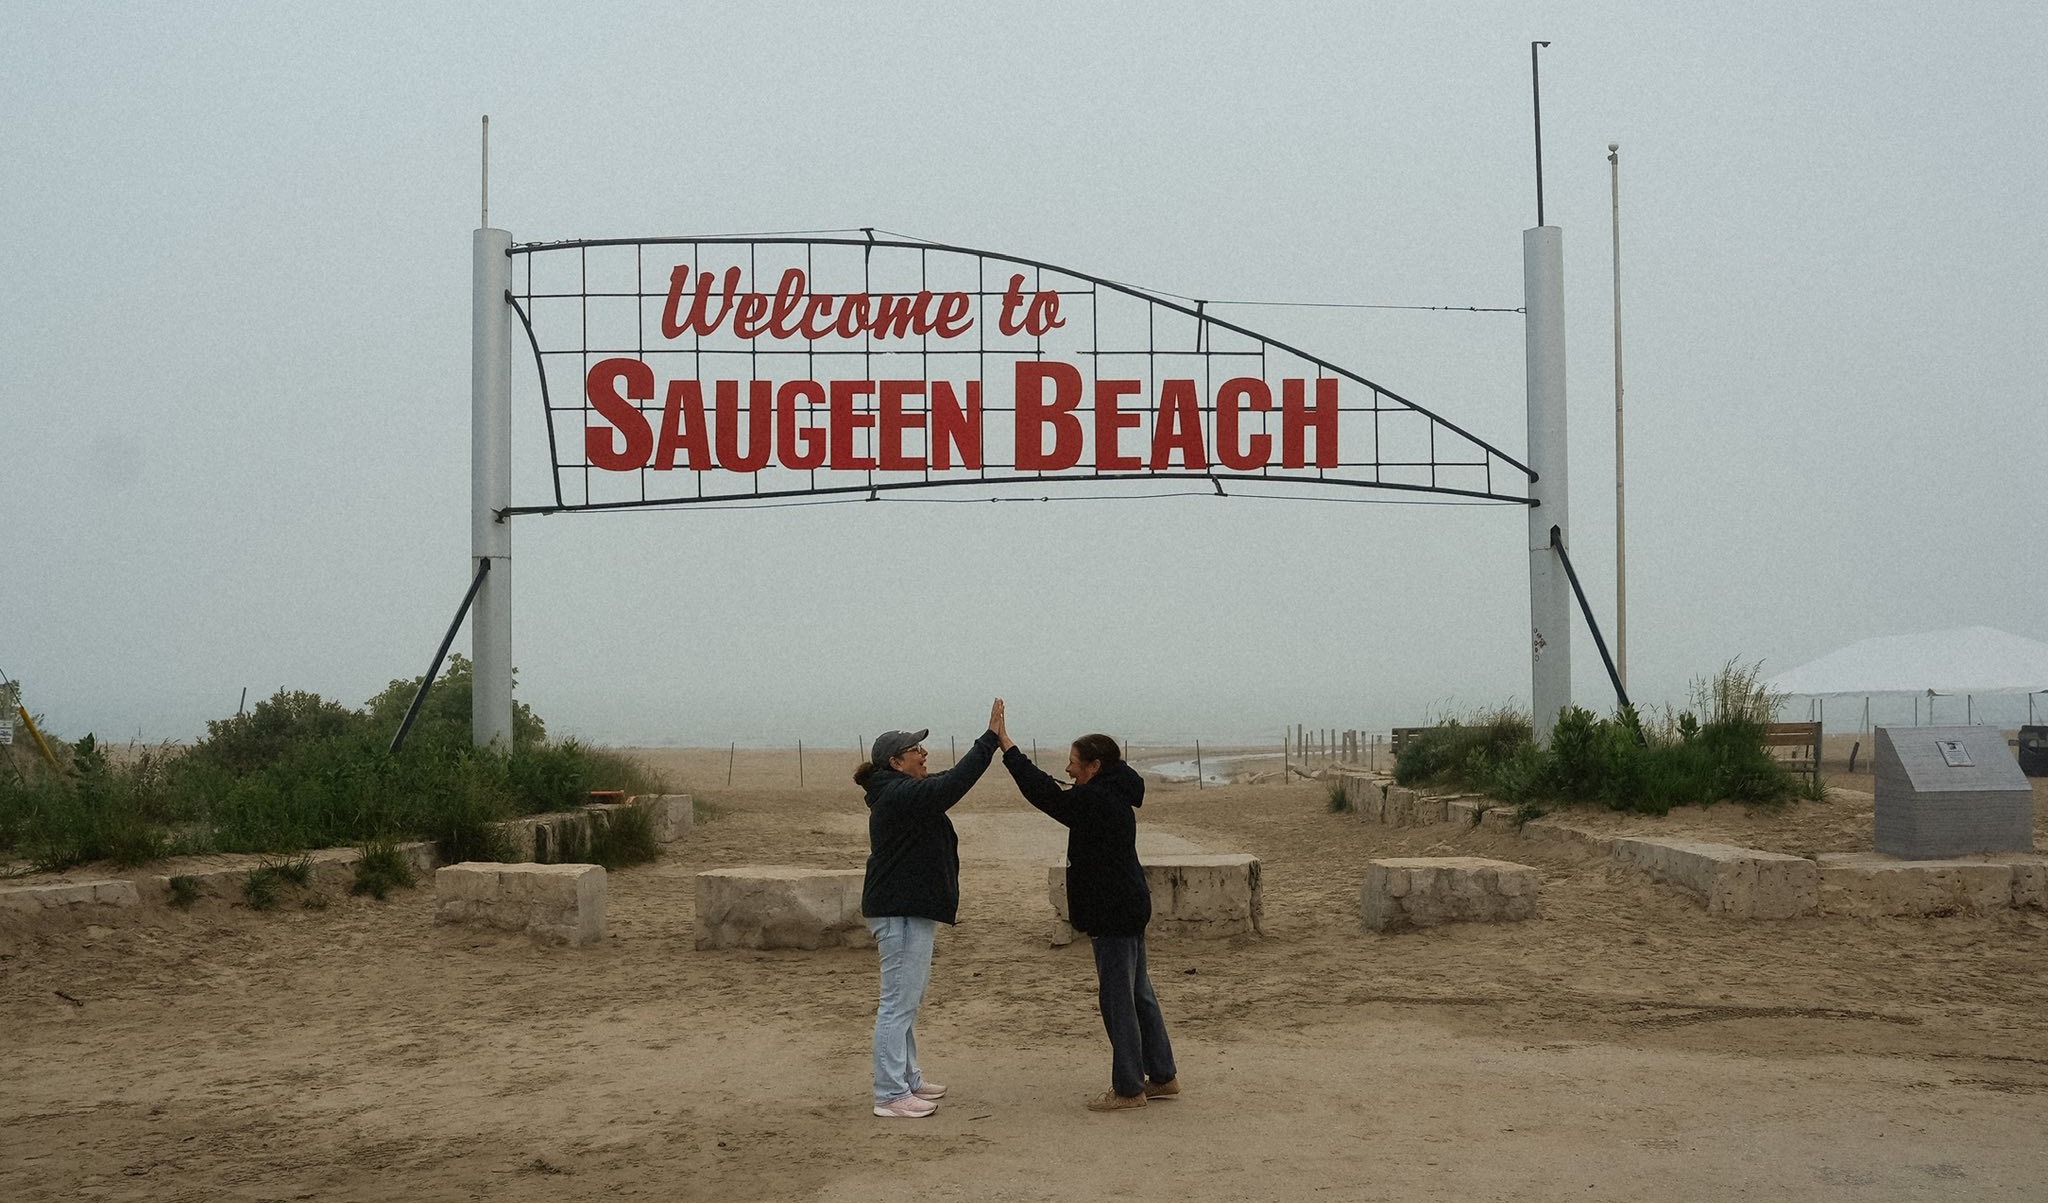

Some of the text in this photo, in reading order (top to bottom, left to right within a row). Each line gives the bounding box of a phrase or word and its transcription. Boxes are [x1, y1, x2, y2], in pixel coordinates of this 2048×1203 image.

[662, 265, 1066, 339] Welcome to
[585, 358, 1339, 471] SAUGEEN BEACH
